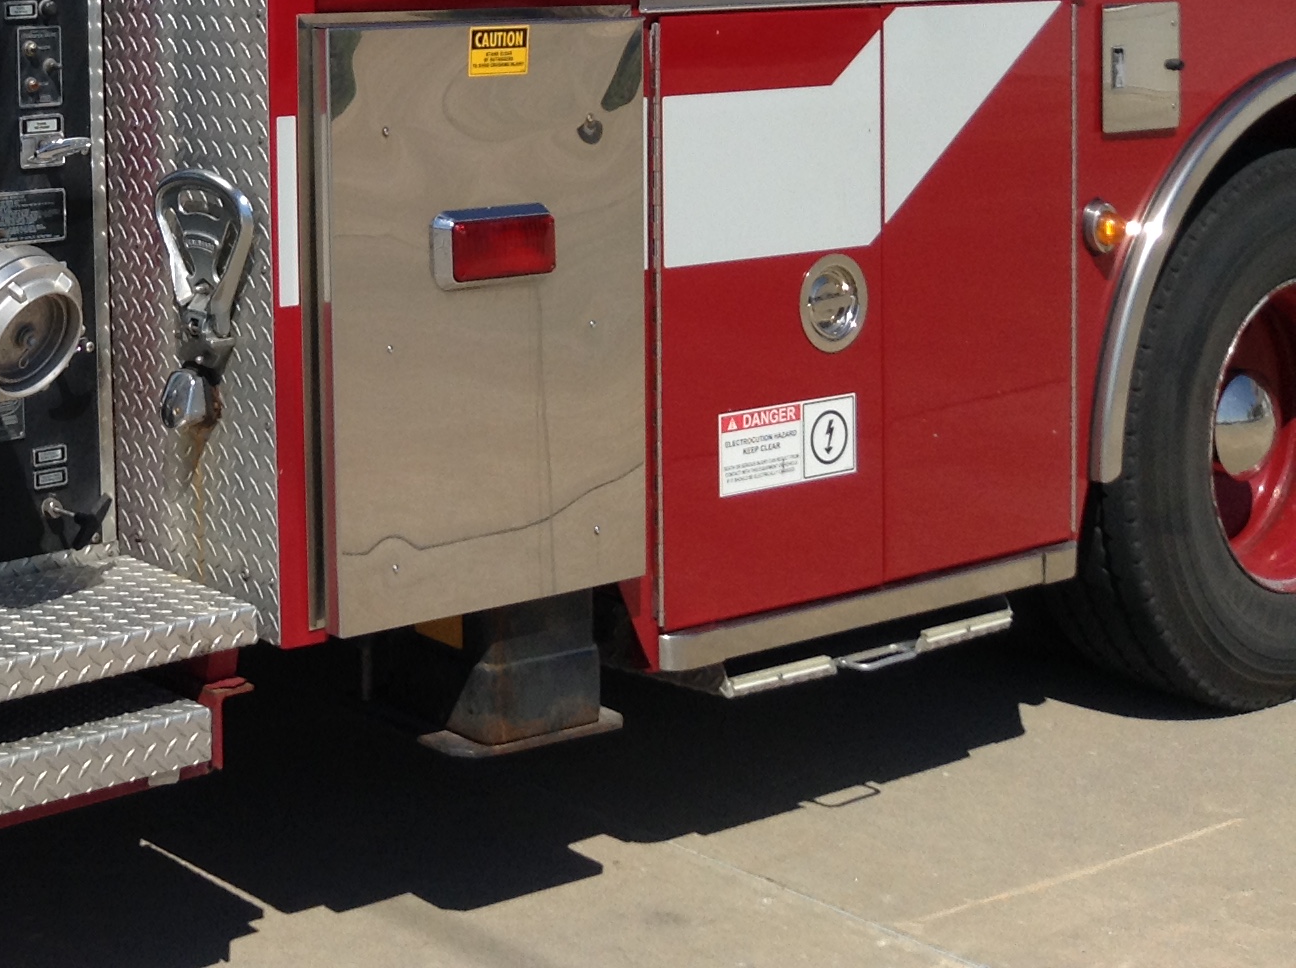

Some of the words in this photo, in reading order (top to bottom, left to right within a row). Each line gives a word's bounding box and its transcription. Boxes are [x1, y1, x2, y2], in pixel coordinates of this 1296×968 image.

[475, 31, 523, 47] CAUTION
[742, 406, 796, 428] DANGER
[724, 434, 773, 448] ELECTROCUTION
[774, 430, 798, 440] HAZARD
[743, 444, 759, 455] KEEP
[760, 442, 781, 452] CLEAR
